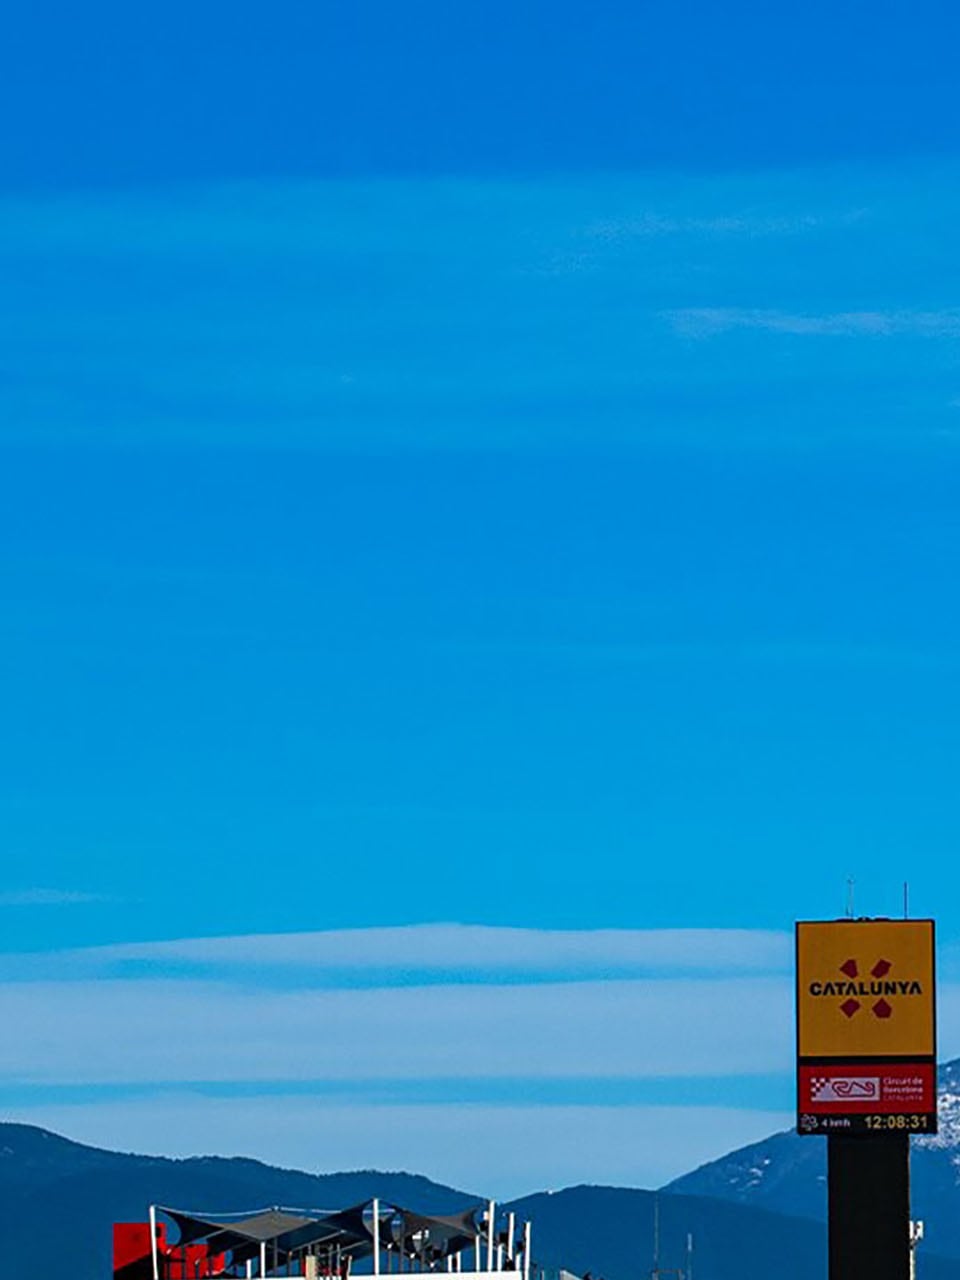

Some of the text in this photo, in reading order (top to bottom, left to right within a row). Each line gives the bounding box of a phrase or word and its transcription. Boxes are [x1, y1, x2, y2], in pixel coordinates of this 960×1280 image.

[809, 981, 922, 996] CATALUNYA
[883, 1077, 923, 1085] Circuit de
[864, 1115, 928, 1129] 12:08:31
